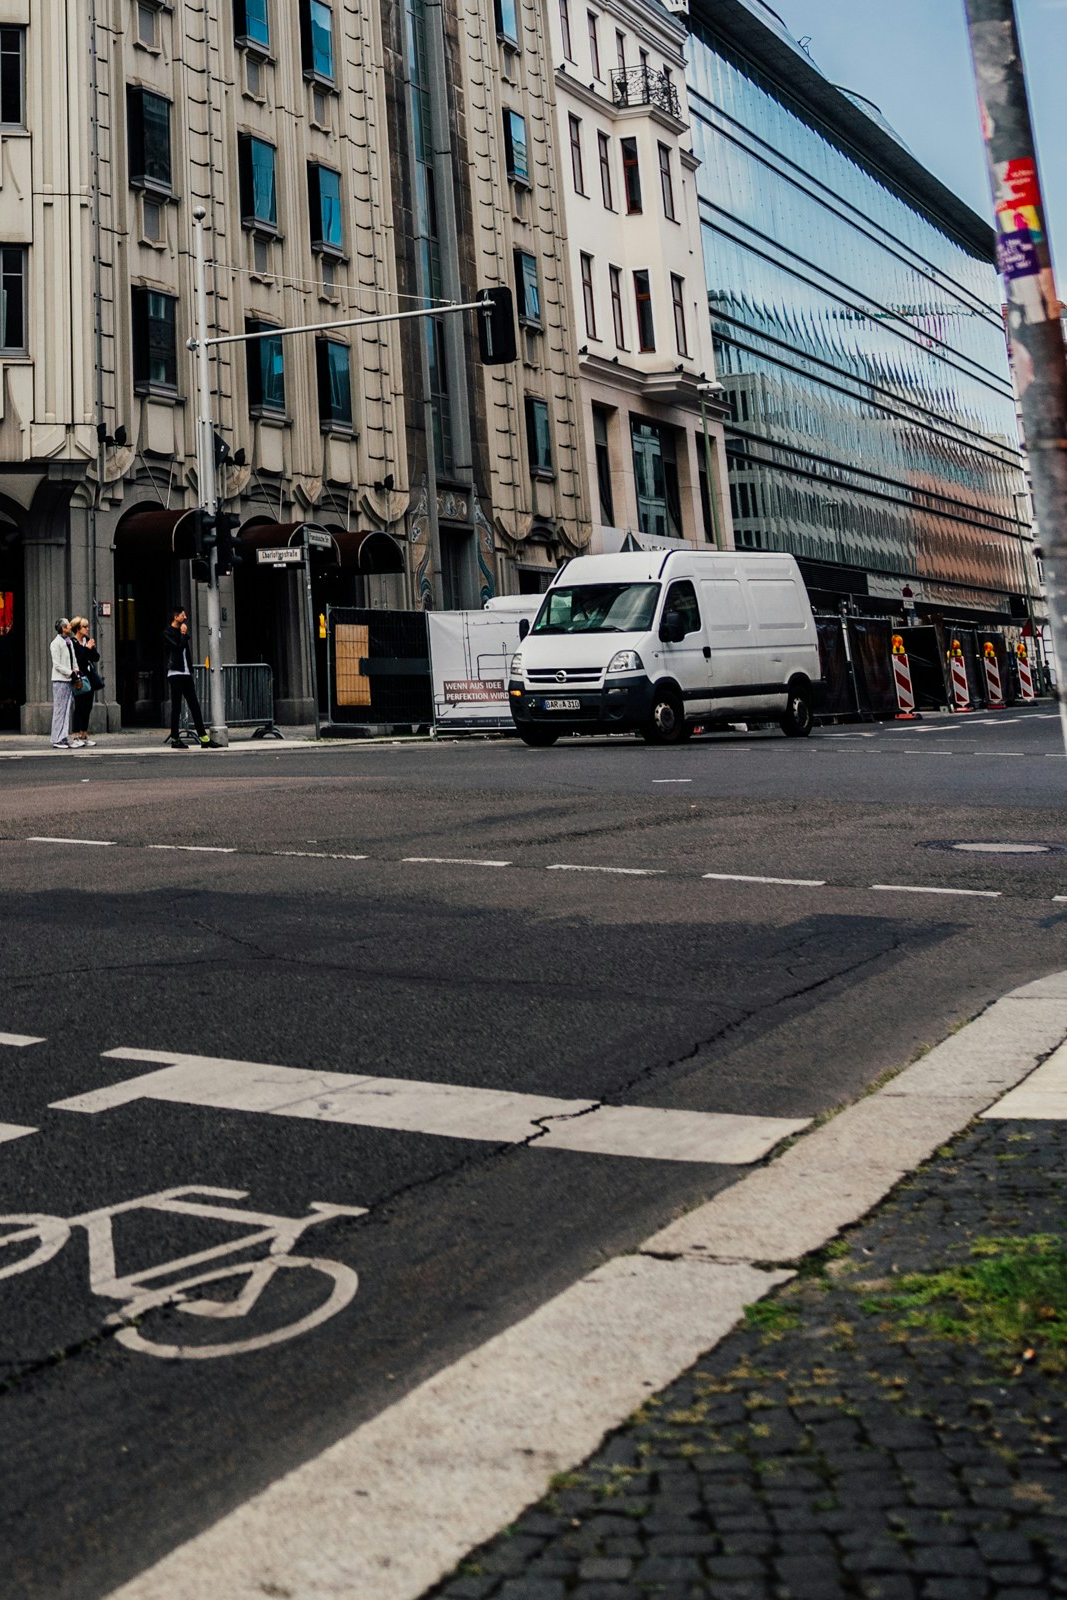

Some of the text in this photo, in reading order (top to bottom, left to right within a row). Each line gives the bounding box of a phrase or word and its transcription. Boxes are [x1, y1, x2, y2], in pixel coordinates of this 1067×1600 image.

[445, 681, 502, 690] WENN AUS IDEE
[446, 691, 510, 701] PERFEKTION WIRD
[546, 701, 559, 709] BAR
[567, 700, 580, 708] 310
